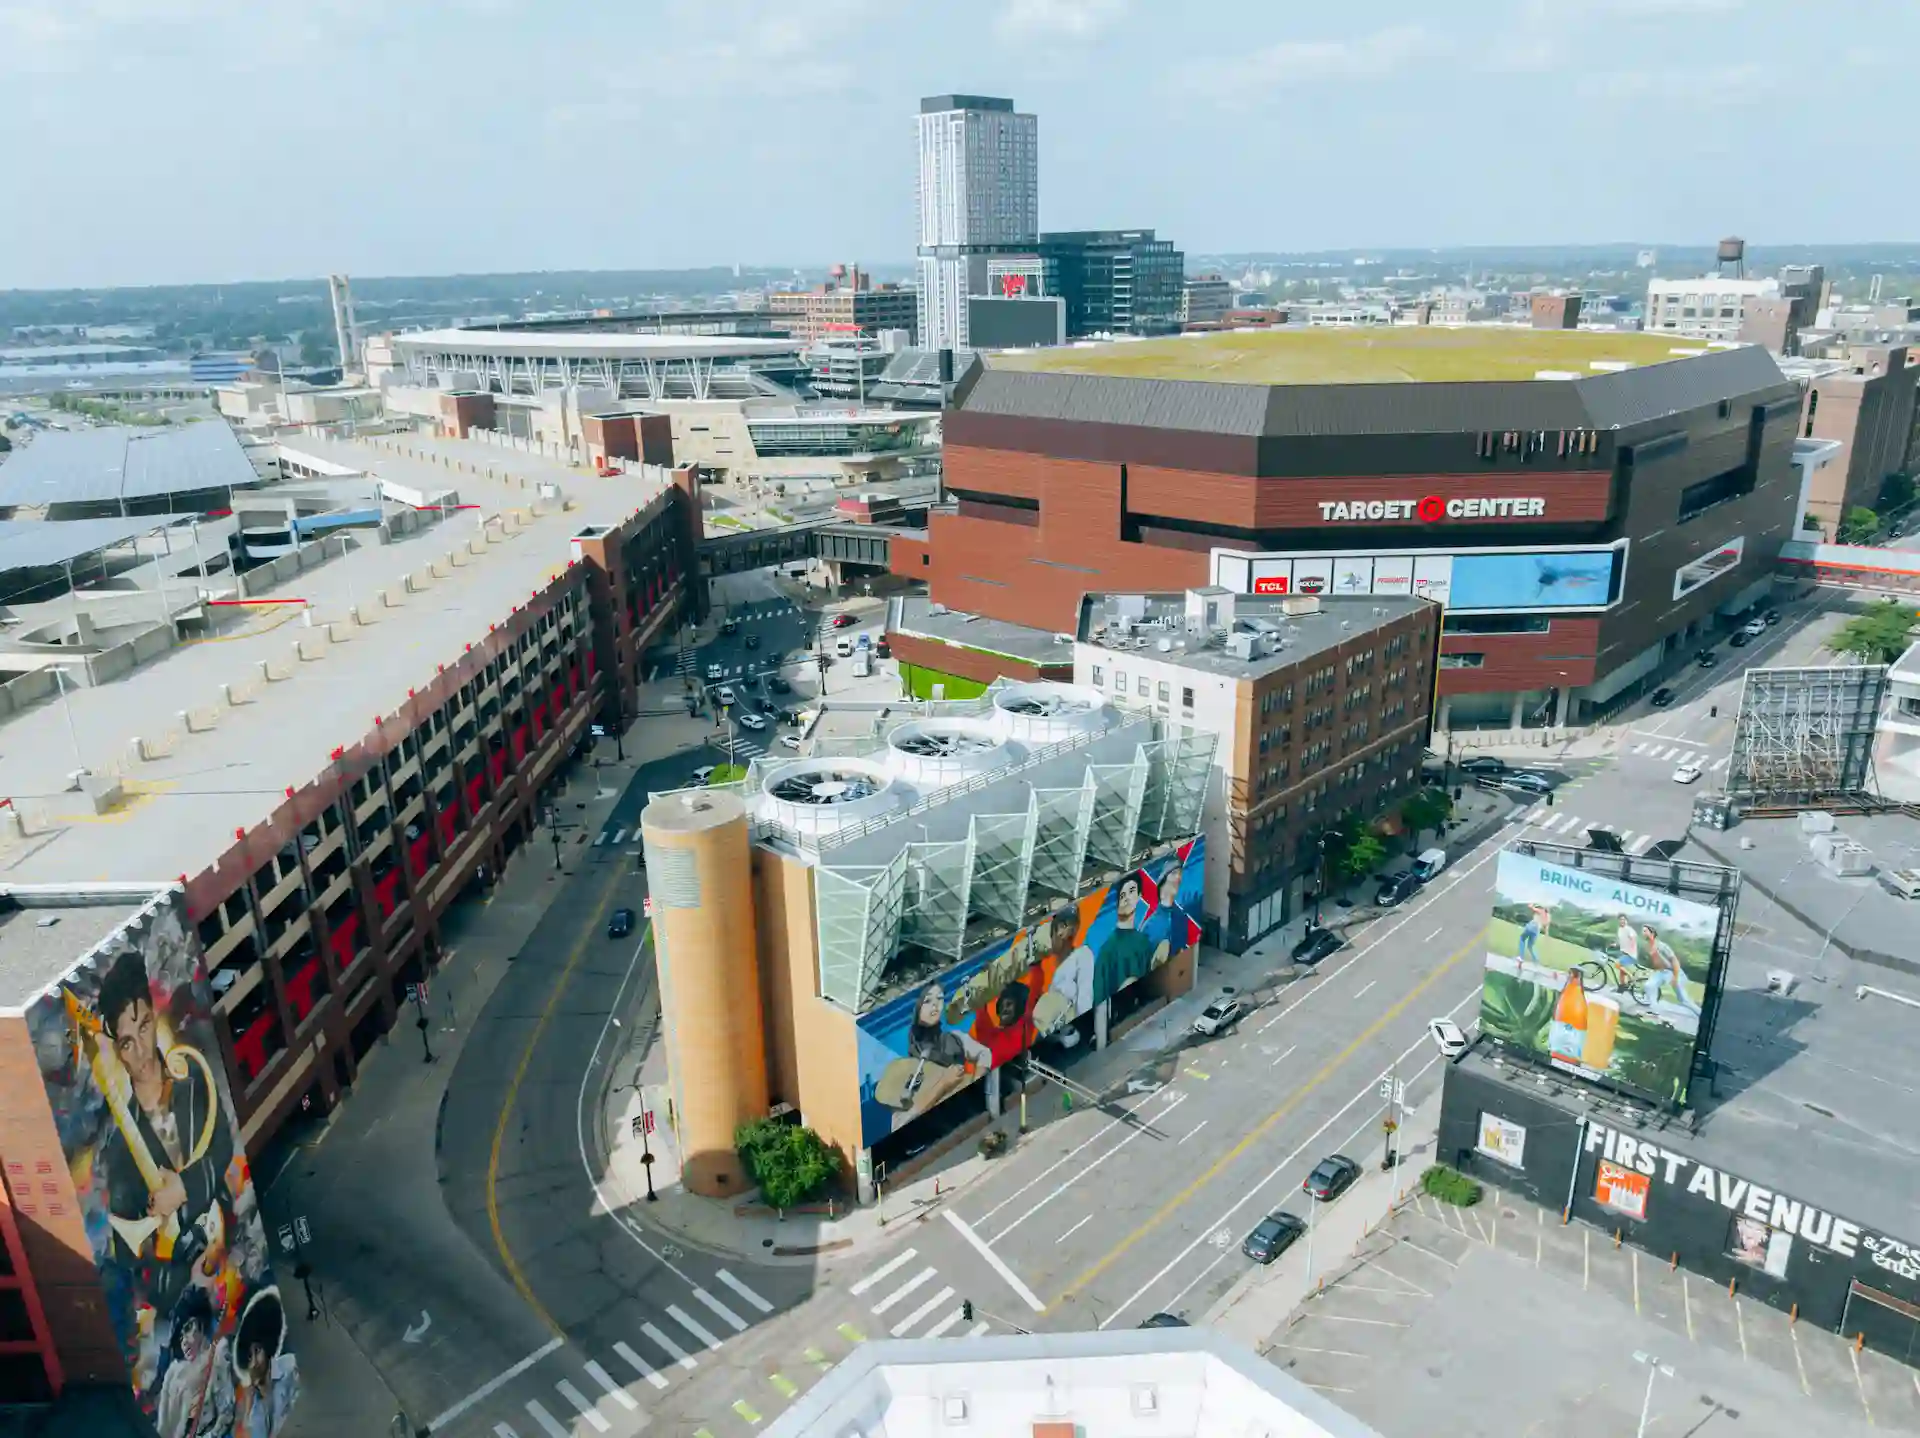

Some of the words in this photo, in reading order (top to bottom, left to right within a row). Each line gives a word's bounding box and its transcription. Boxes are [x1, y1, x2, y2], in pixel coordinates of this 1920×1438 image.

[1318, 500, 1417, 520] TARGET
[1446, 497, 1545, 517] CENTER
[1259, 582, 1284, 592] TCL
[1540, 867, 1593, 894] BRING
[1611, 889, 1672, 917] ALOHA
[1584, 1121, 1688, 1185] FIRST
[1686, 1164, 1861, 1258] AVENUE
[1862, 1235, 1880, 1252] &
